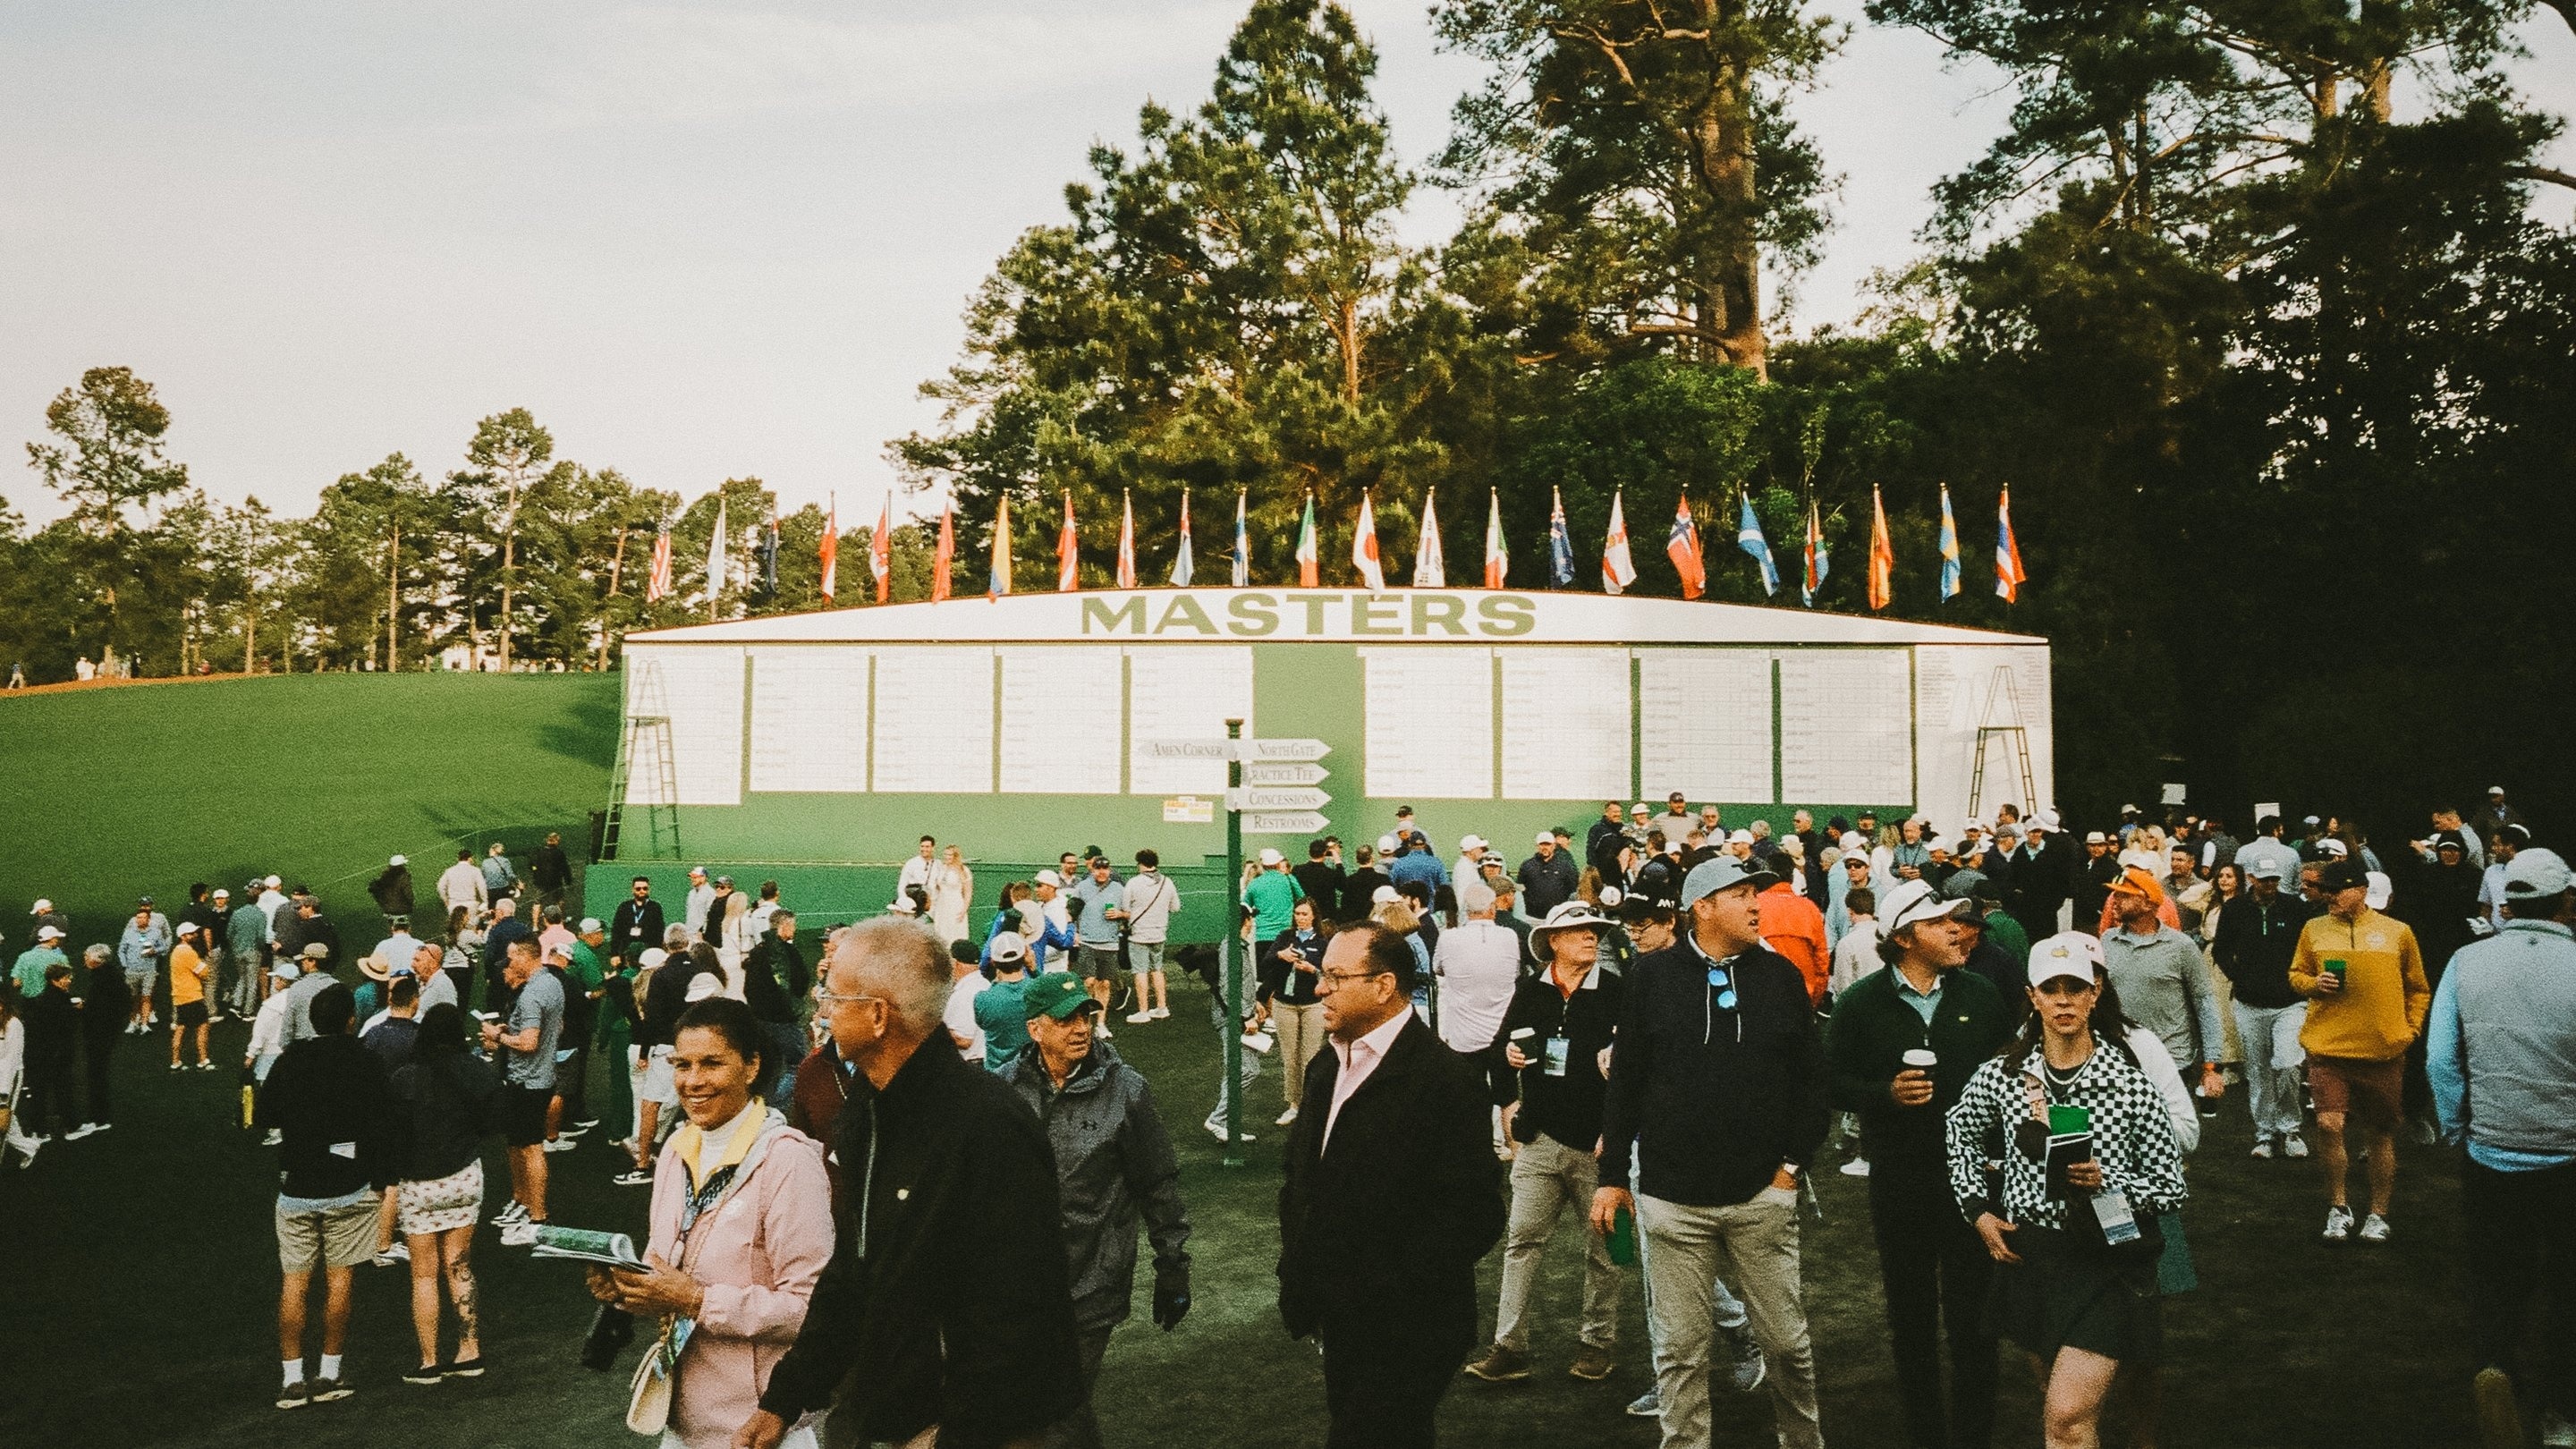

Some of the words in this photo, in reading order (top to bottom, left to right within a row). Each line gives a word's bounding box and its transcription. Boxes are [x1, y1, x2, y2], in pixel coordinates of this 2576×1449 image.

[1081, 593, 1537, 637] MASTERS
[1182, 742, 1224, 758] CORNER
[1249, 767, 1292, 781] RACTICE
[1293, 766, 1316, 781] TEE
[1248, 792, 1318, 806] CONCESSIONS
[1253, 815, 1316, 829] RESTROOMS
